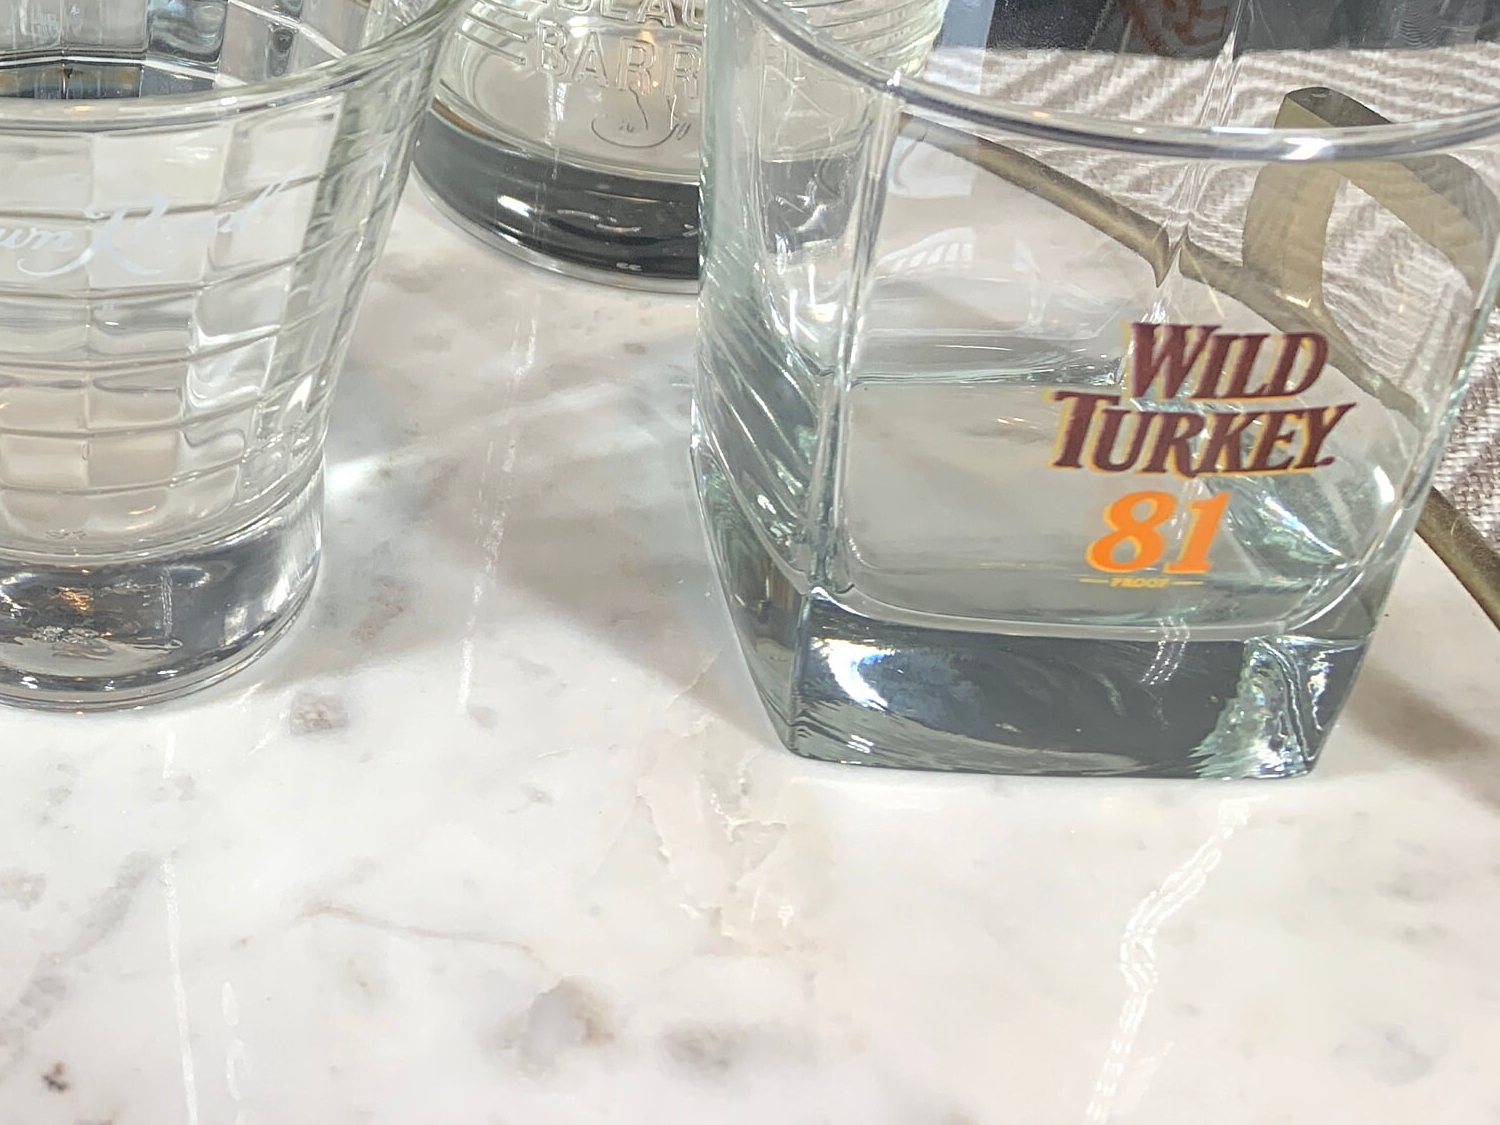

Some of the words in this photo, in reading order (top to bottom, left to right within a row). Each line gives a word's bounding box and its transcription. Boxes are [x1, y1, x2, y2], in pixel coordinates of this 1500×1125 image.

[1122, 320, 1330, 402] WILD
[1044, 387, 1357, 480] TURKEY
[1085, 489, 1233, 574] 81
